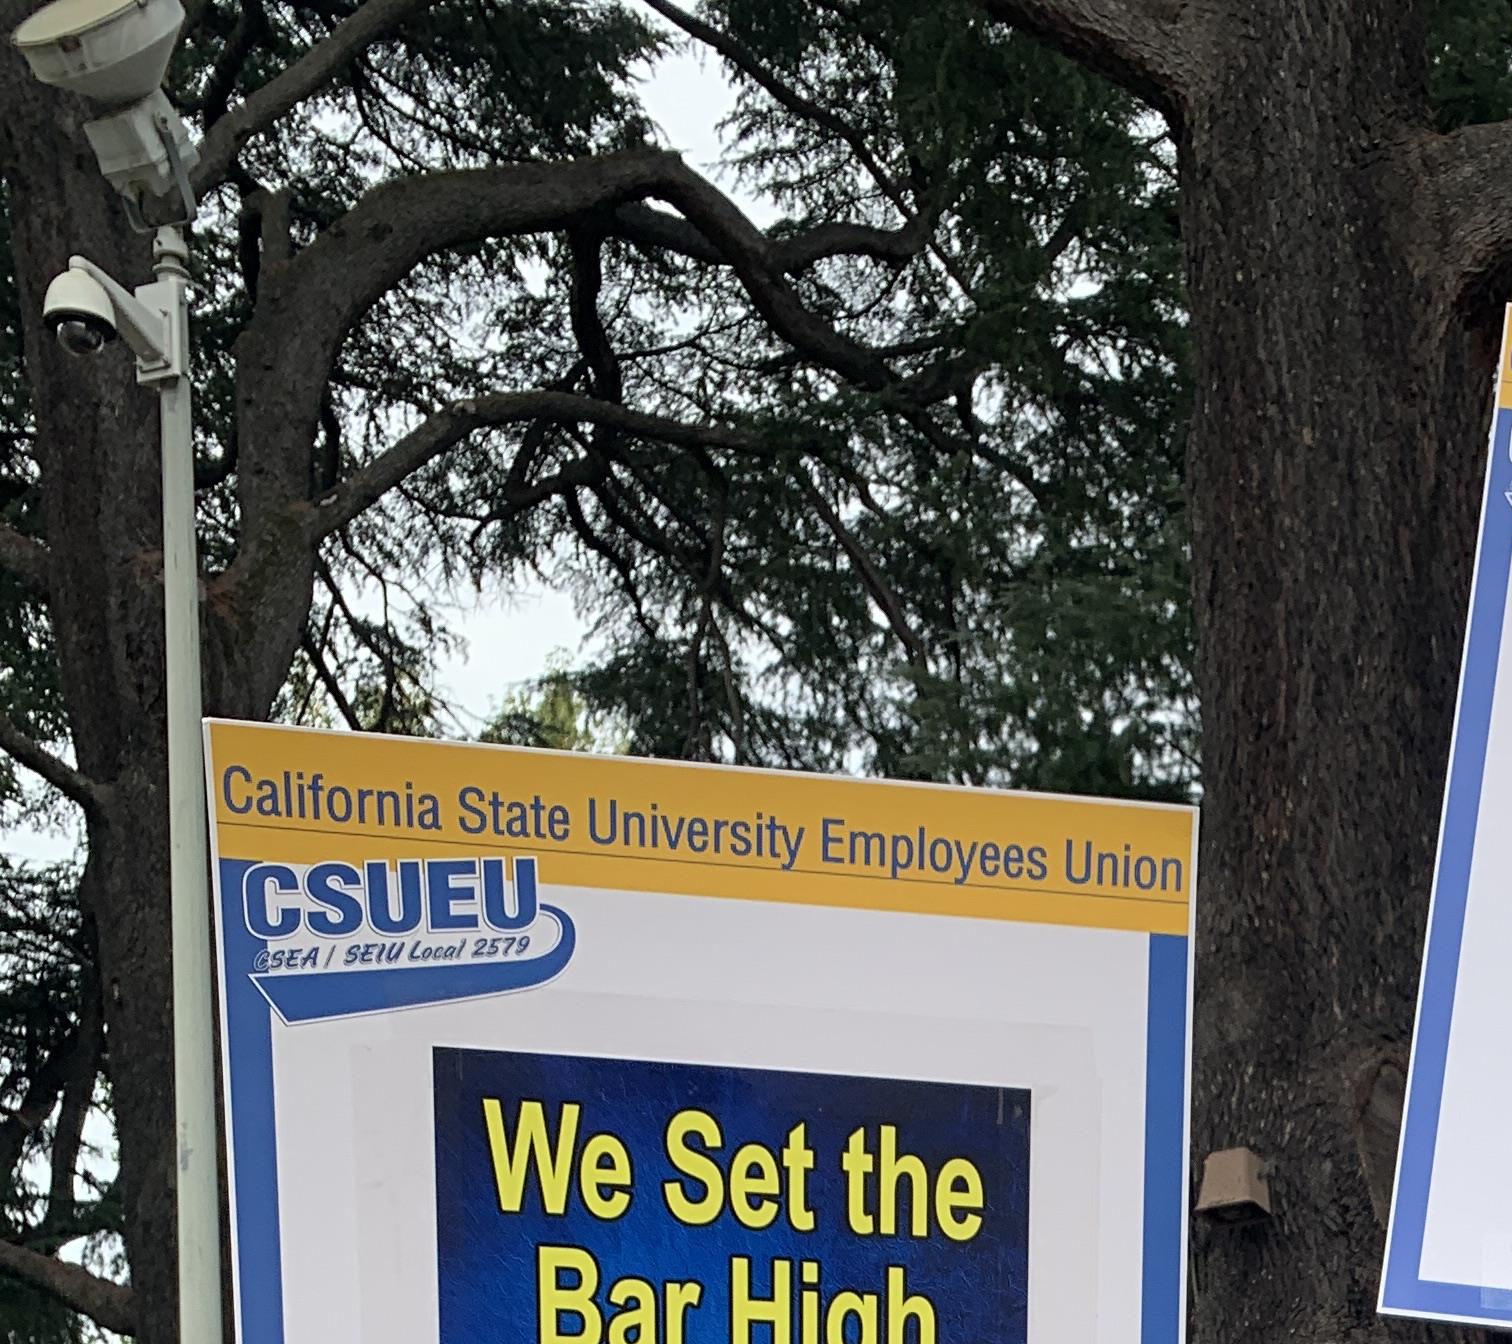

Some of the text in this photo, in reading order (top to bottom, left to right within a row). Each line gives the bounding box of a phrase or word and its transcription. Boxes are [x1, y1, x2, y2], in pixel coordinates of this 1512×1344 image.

[221, 764, 1184, 893] California State University Employees Union
[242, 858, 540, 938] CSUEU
[253, 935, 531, 971] CSEA / SEIU Local 2579
[482, 1097, 985, 1241] We Set the
